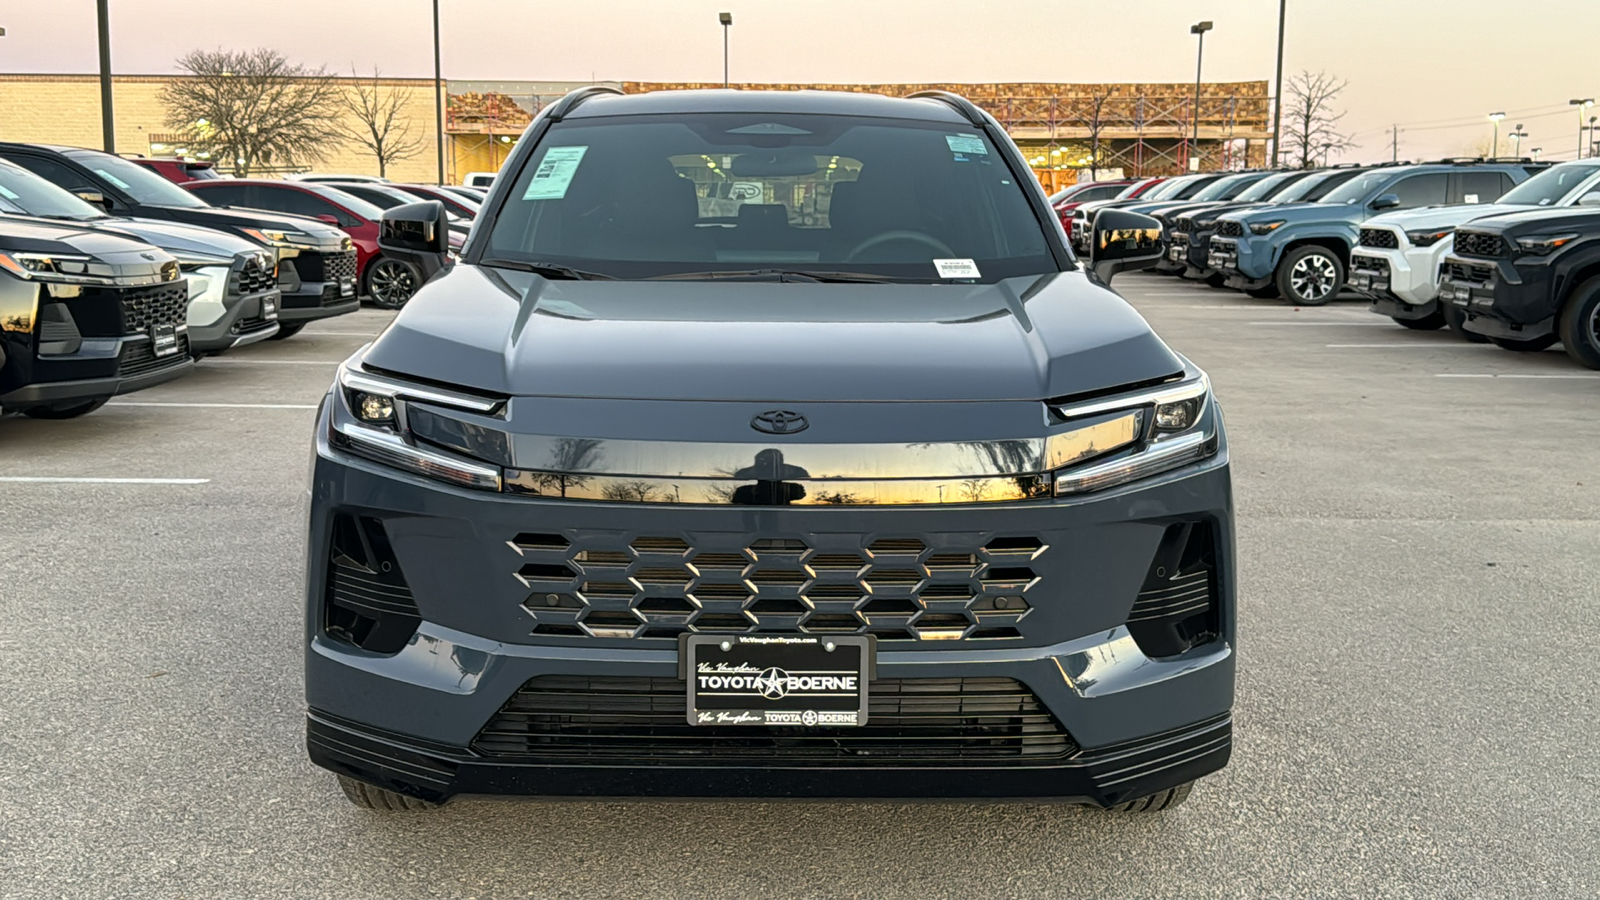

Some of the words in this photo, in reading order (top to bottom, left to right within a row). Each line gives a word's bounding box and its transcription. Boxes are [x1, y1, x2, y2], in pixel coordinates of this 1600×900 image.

[697, 676, 764, 690] TOYOTA
[787, 676, 858, 690] BOERNE
[764, 713, 802, 722] TOYOTA
[818, 714, 858, 723] BOERNE
